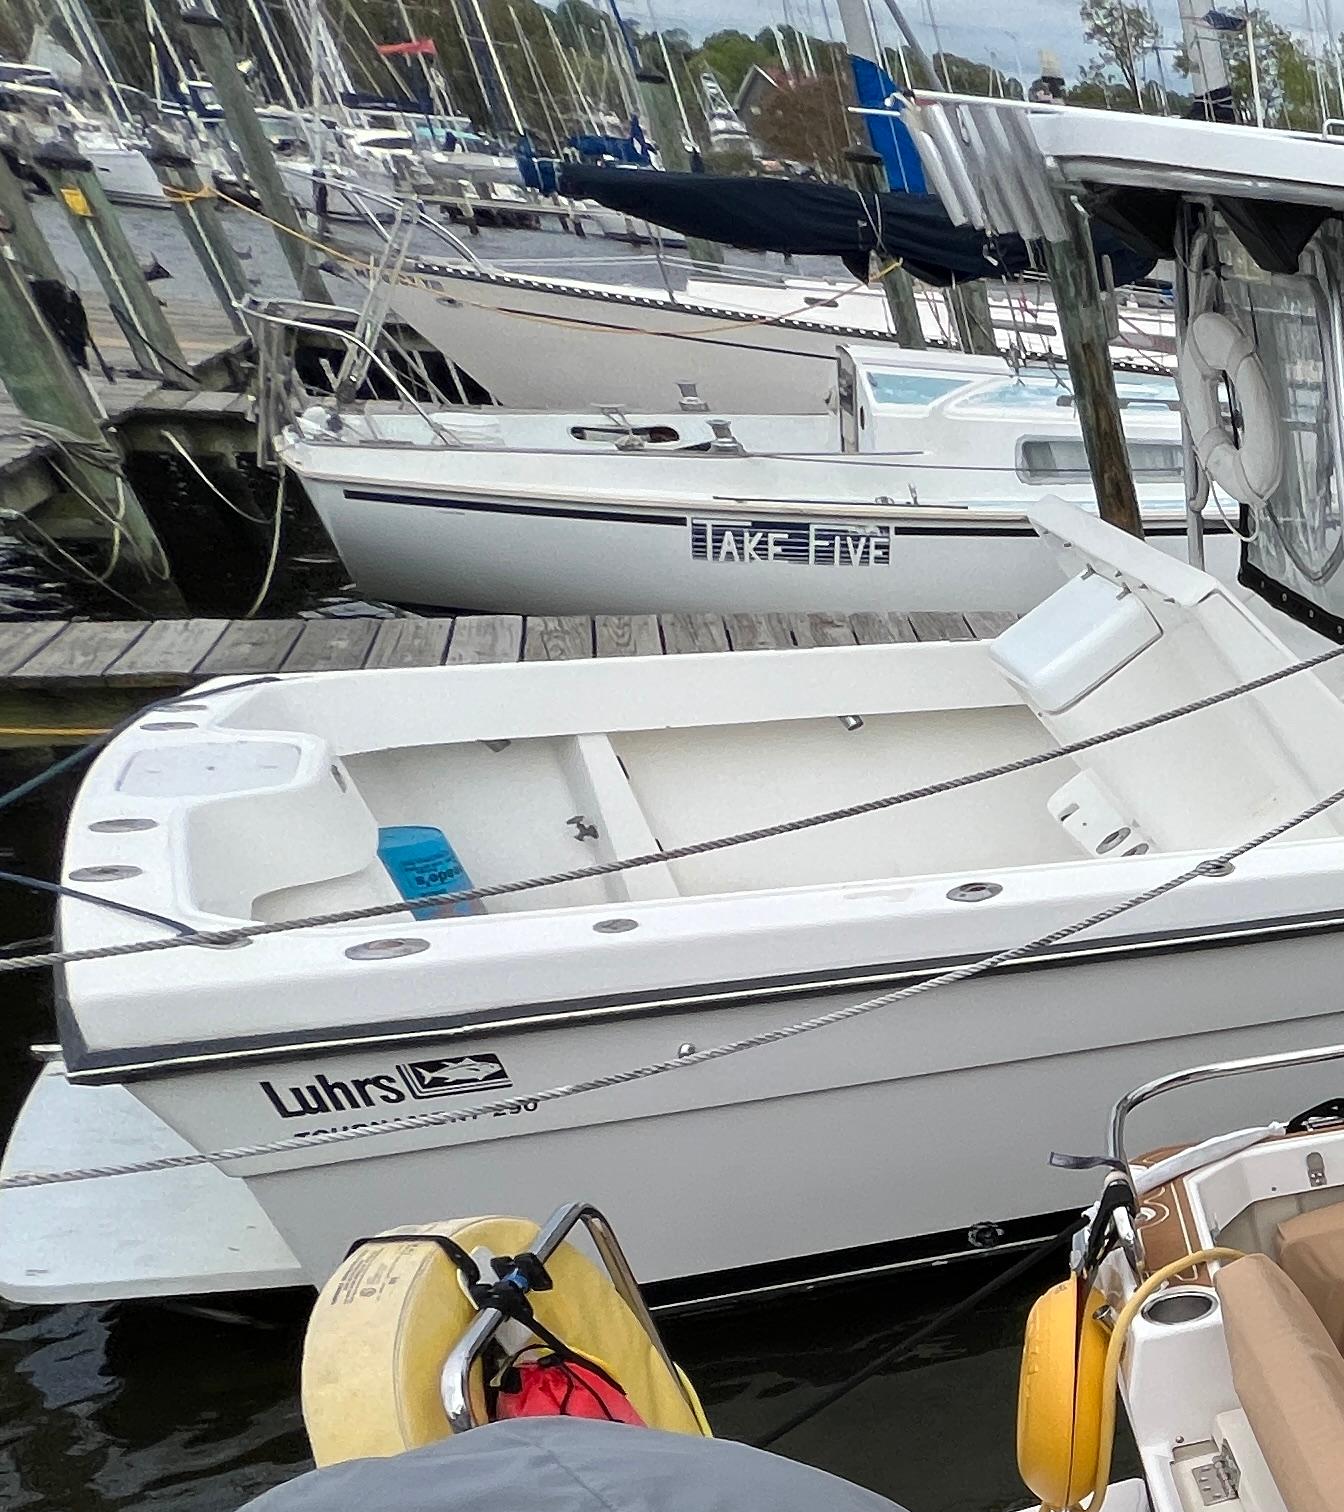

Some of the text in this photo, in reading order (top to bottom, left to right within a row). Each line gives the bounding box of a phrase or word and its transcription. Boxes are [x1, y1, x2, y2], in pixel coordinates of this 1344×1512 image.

[692, 518, 890, 567] TAKE FIVE
[259, 1074, 406, 1118] Luhrs
